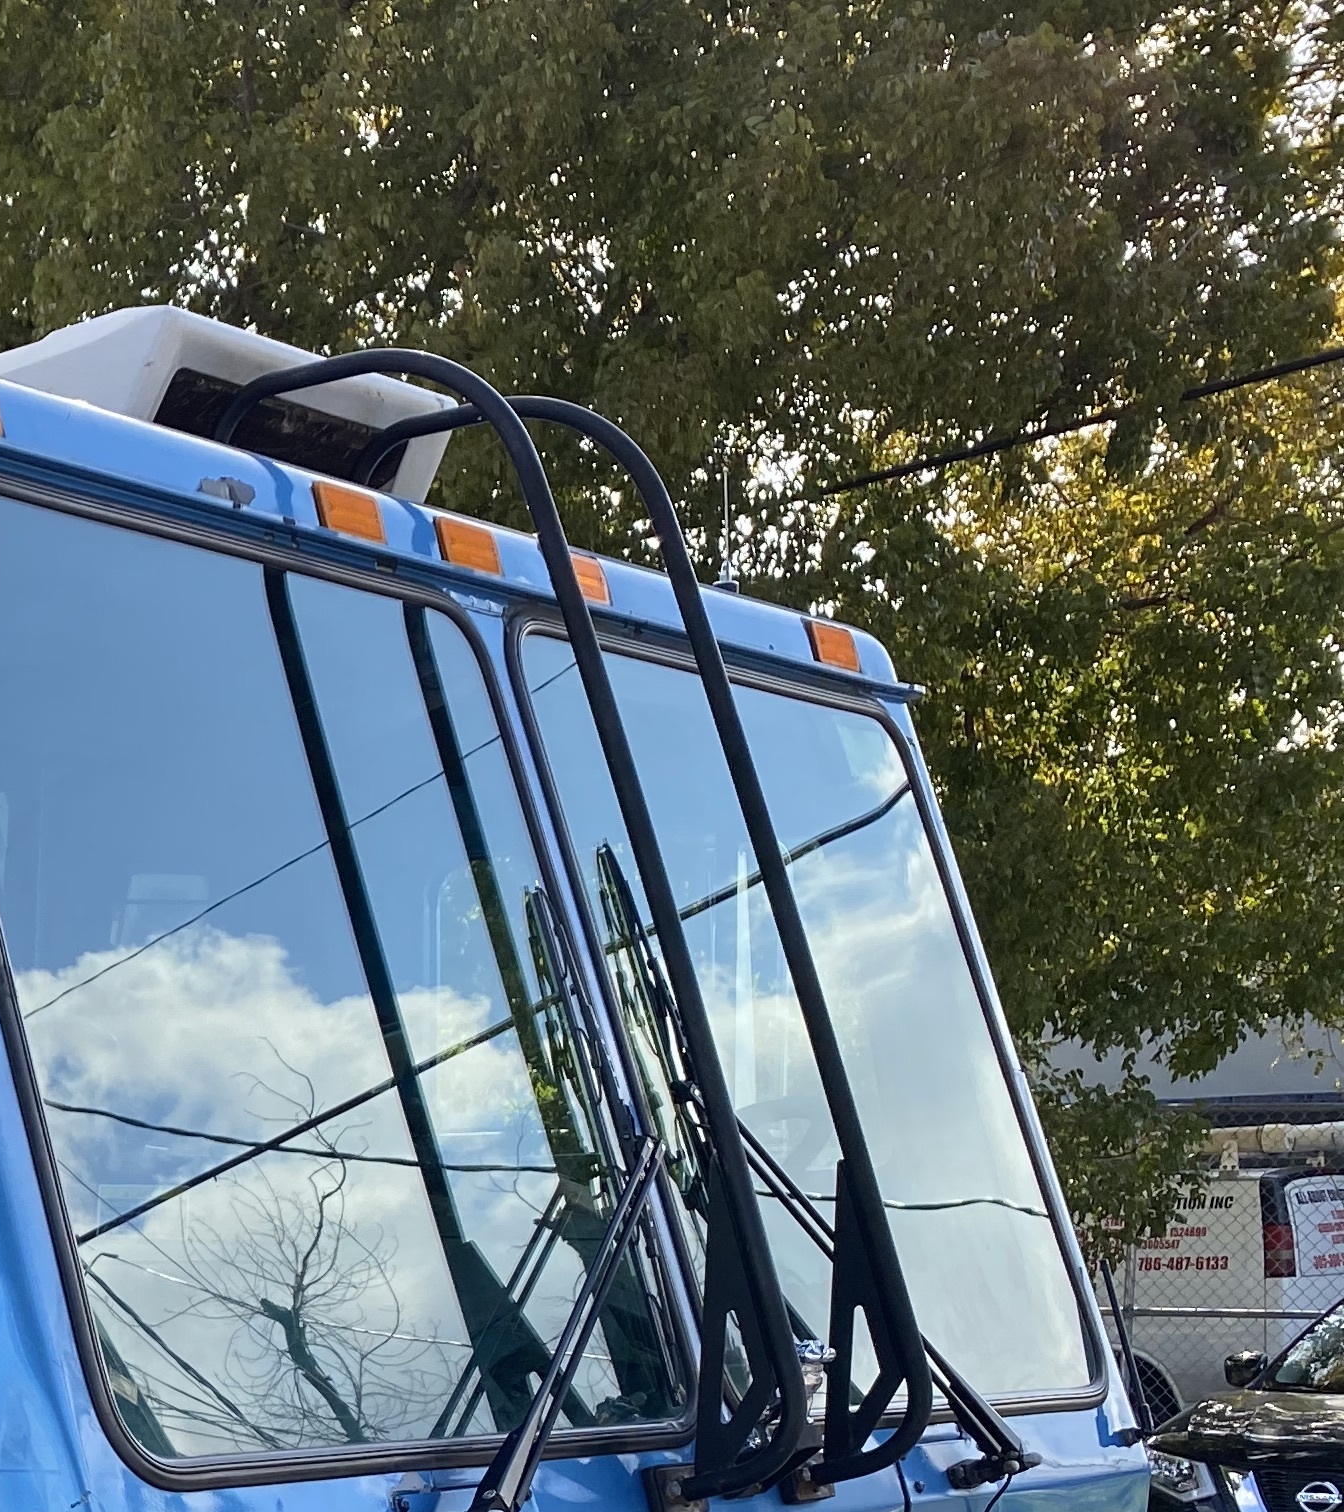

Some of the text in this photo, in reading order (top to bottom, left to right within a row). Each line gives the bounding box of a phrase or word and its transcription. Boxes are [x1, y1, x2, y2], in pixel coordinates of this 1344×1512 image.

[1209, 1196, 1234, 1209] INC
[1138, 1256, 1229, 1271] 786-487-6133
[1299, 1494, 1337, 1502] NISSAN
